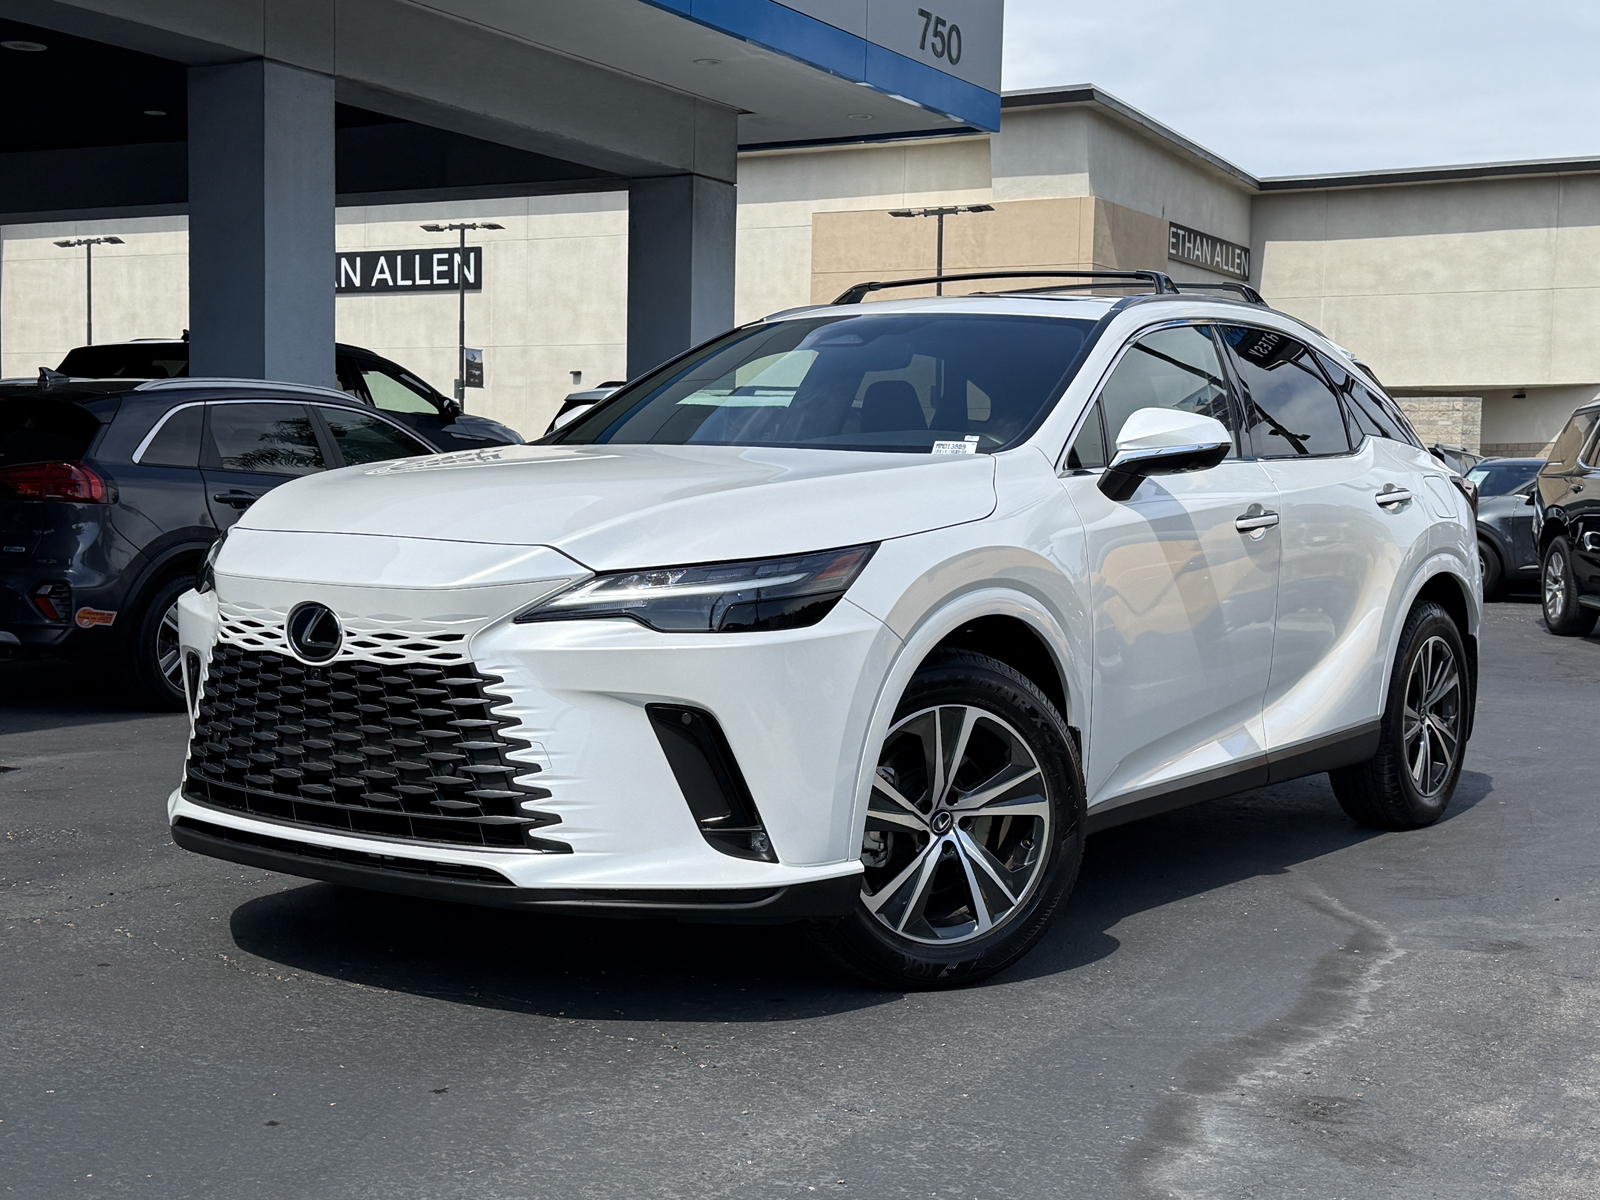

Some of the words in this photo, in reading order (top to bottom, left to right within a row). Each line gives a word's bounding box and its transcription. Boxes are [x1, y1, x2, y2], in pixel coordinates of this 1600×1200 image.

[918, 8, 962, 65] 750
[371, 252, 475, 287] ALLEN
[1169, 226, 1211, 265] ETHAN
[1213, 242, 1249, 277] ALLEN
